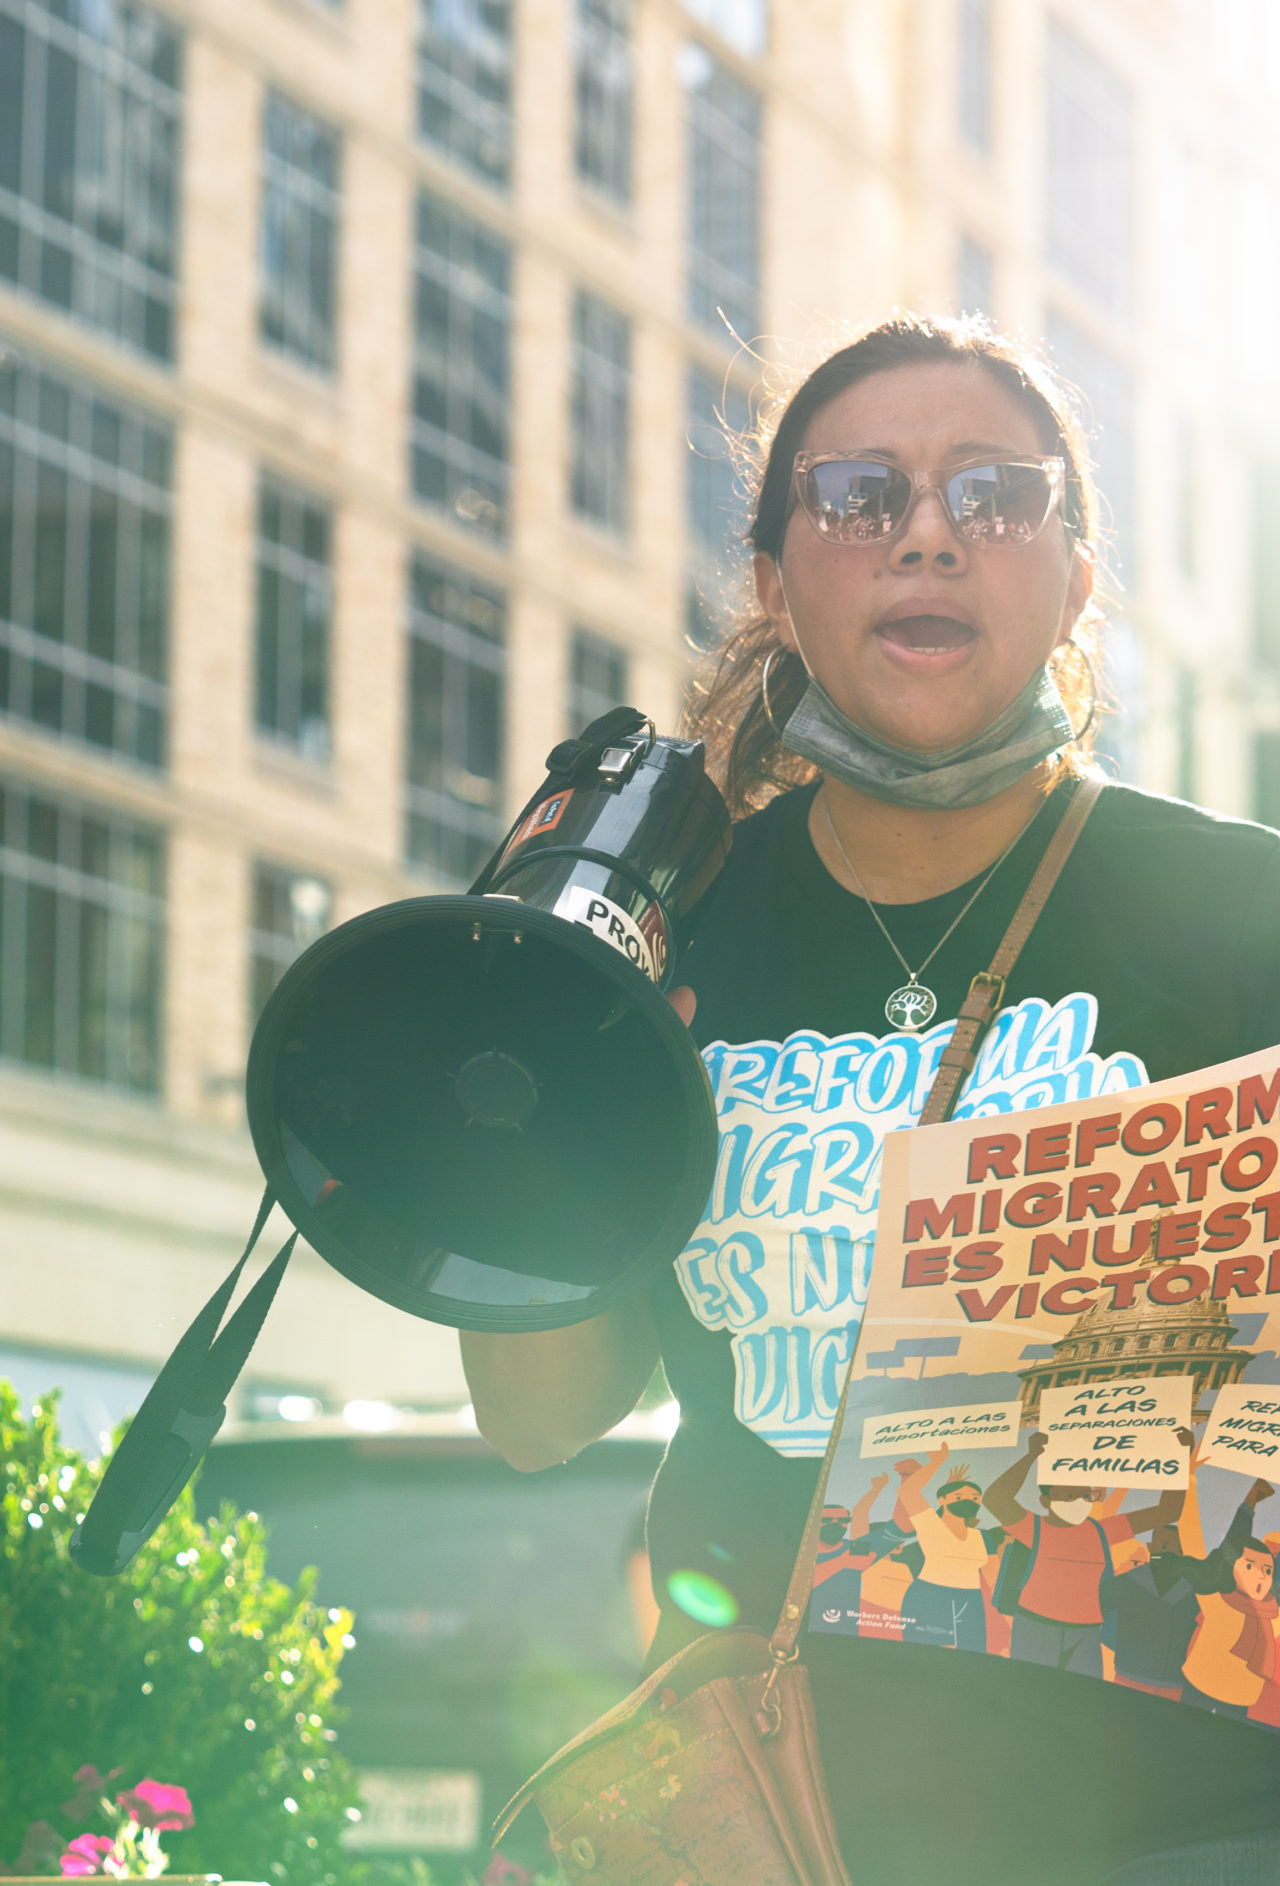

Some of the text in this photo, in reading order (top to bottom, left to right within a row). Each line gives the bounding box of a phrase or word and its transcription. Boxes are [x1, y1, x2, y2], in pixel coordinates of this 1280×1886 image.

[902, 1240, 1004, 1289] ES
[677, 1230, 768, 1329] ES
[1073, 1384, 1146, 1400] ALTO
[1064, 1398, 1158, 1417] A LAS
[875, 1411, 1007, 1435] ALTO A LAS
[1047, 1416, 1178, 1432] SEPARACIONES
[871, 1423, 1011, 1445] deportaciones
[1092, 1434, 1138, 1451] DE
[1211, 1435, 1280, 1458] PARA
[1051, 1457, 1181, 1476] FAMILIAS
[846, 1610, 917, 1624] Workers Defense
[855, 1618, 883, 1628] Action
[884, 1622, 907, 1631] Fund
